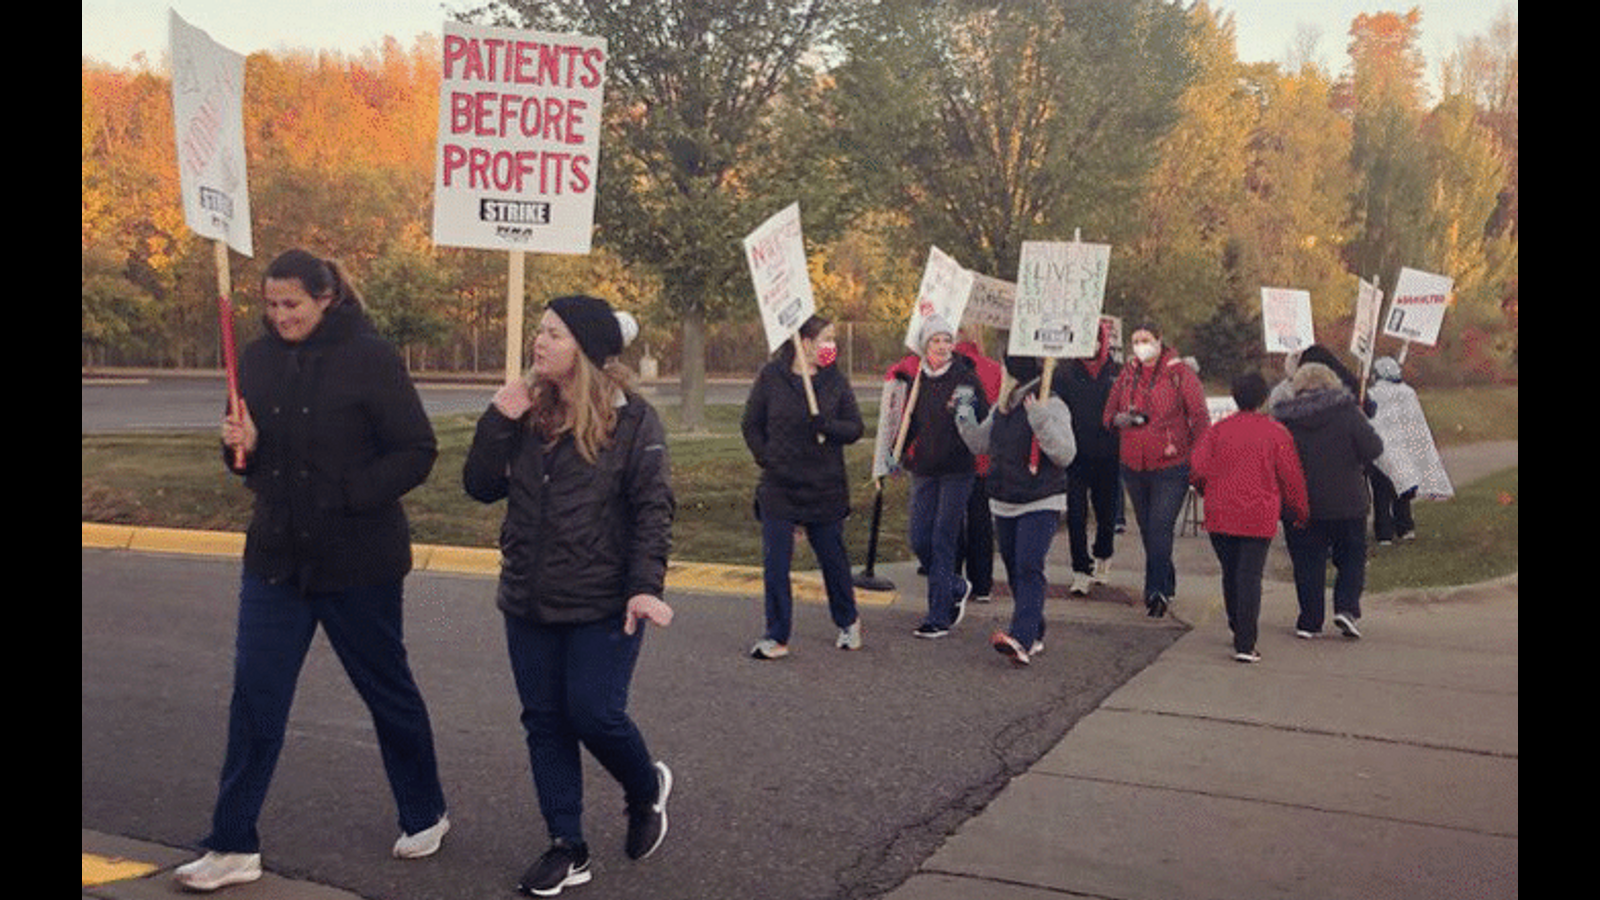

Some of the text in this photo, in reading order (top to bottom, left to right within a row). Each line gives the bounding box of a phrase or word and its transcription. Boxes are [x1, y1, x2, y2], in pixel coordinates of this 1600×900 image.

[443, 34, 605, 89] PATIENTS
[451, 91, 588, 144] BEFORE
[443, 144, 591, 195] PROFITS
[482, 201, 549, 224] STRIKE
